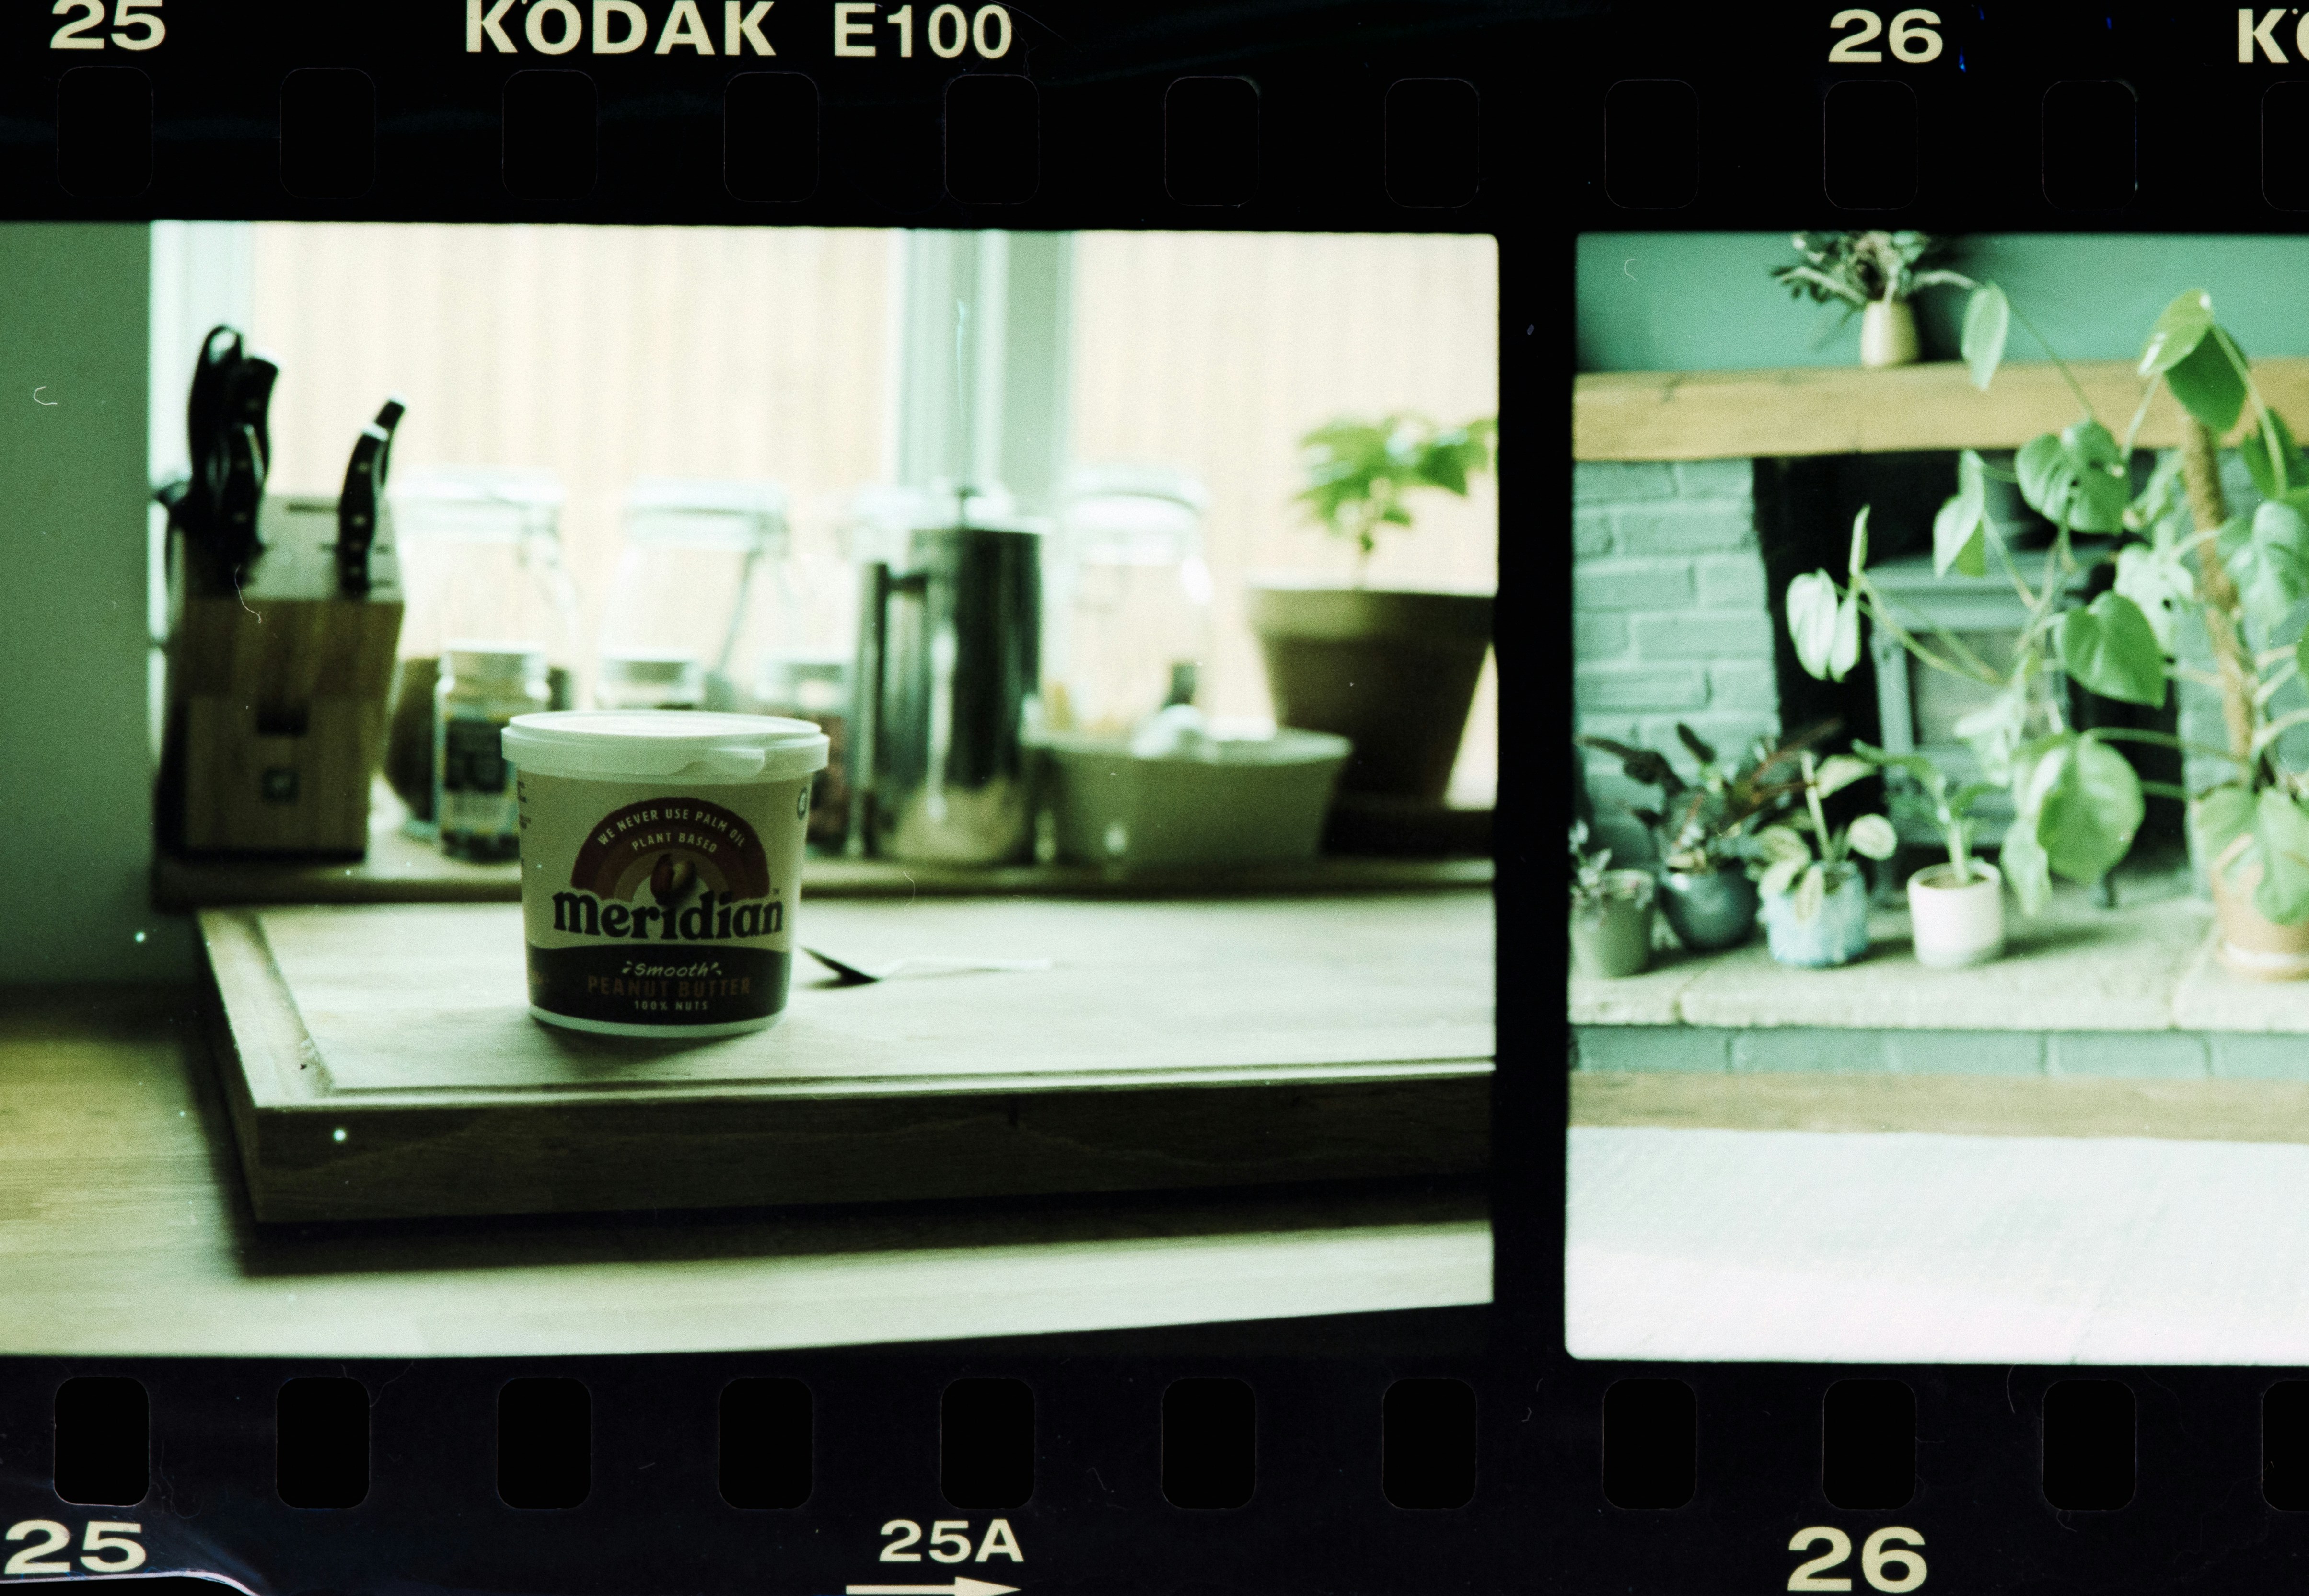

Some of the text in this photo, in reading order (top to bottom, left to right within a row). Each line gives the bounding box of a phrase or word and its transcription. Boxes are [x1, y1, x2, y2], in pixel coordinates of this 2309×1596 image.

[50, 0, 165, 51] 25
[466, 0, 1012, 59] KODAK E100
[1829, 9, 1943, 63] 26
[2238, 9, 2309, 63] K
[597, 808, 745, 847] WE NEVER USE PALM OIL
[631, 832, 718, 853] PLANT BASED
[552, 890, 784, 940] meridian
[587, 975, 751, 998] PEANUT BUTTER
[634, 961, 709, 977] Smooth
[634, 1000, 708, 1011] 100% NUTS
[4, 1519, 147, 1575] 25
[879, 1519, 1024, 1563] 25A
[1787, 1526, 1928, 1593] 26
